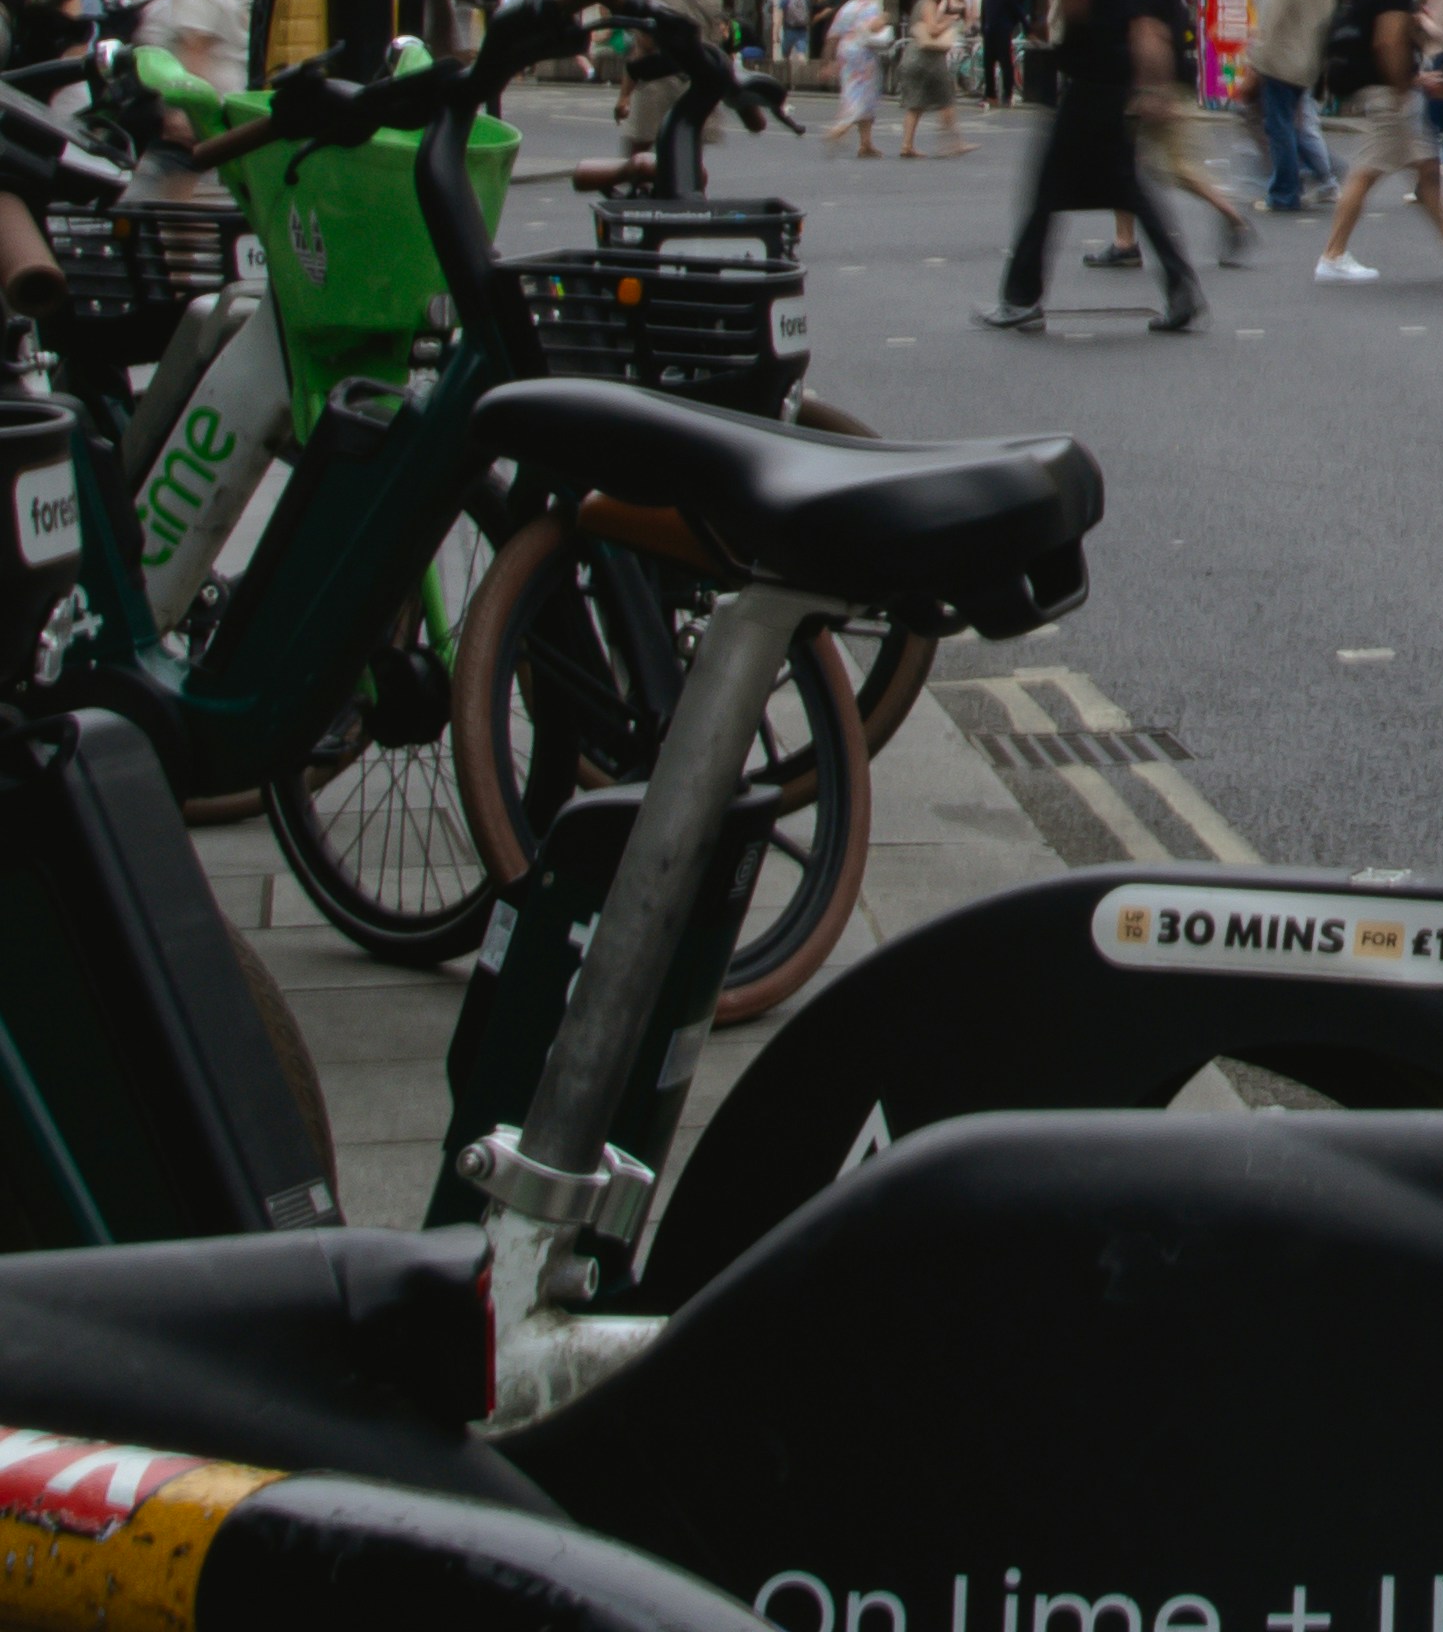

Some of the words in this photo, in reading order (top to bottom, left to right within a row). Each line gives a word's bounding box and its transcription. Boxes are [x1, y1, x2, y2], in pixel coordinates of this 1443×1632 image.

[1123, 924, 1143, 939] TO
[1124, 910, 1145, 923] UP
[1157, 908, 1215, 946] 30
[1224, 912, 1346, 954] MINS
[1361, 930, 1398, 948] FOR
[754, 1572, 906, 1632] On
